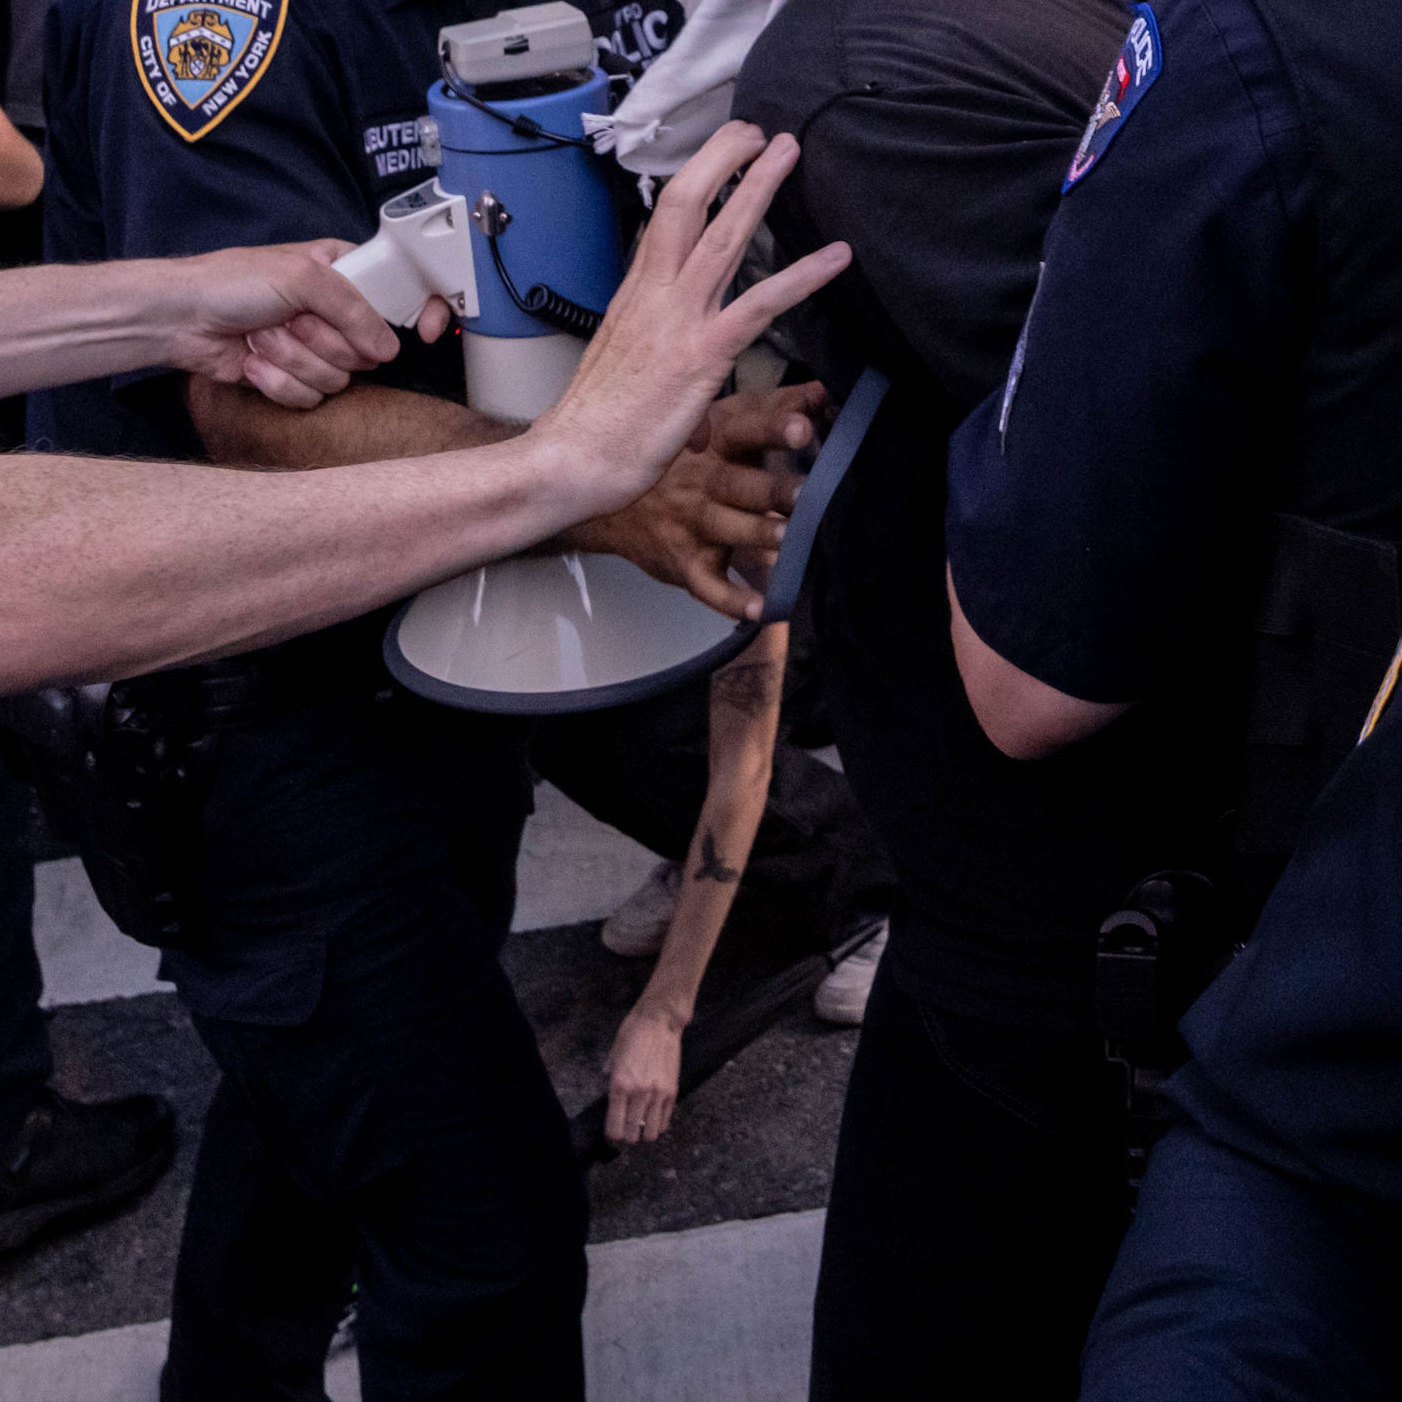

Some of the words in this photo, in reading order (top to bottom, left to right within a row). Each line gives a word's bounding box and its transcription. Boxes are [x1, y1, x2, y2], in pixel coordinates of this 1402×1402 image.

[139, 34, 163, 81] CITY
[155, 81, 178, 107] OF
[201, 77, 239, 117] NEW
[234, 29, 273, 81] YORK
